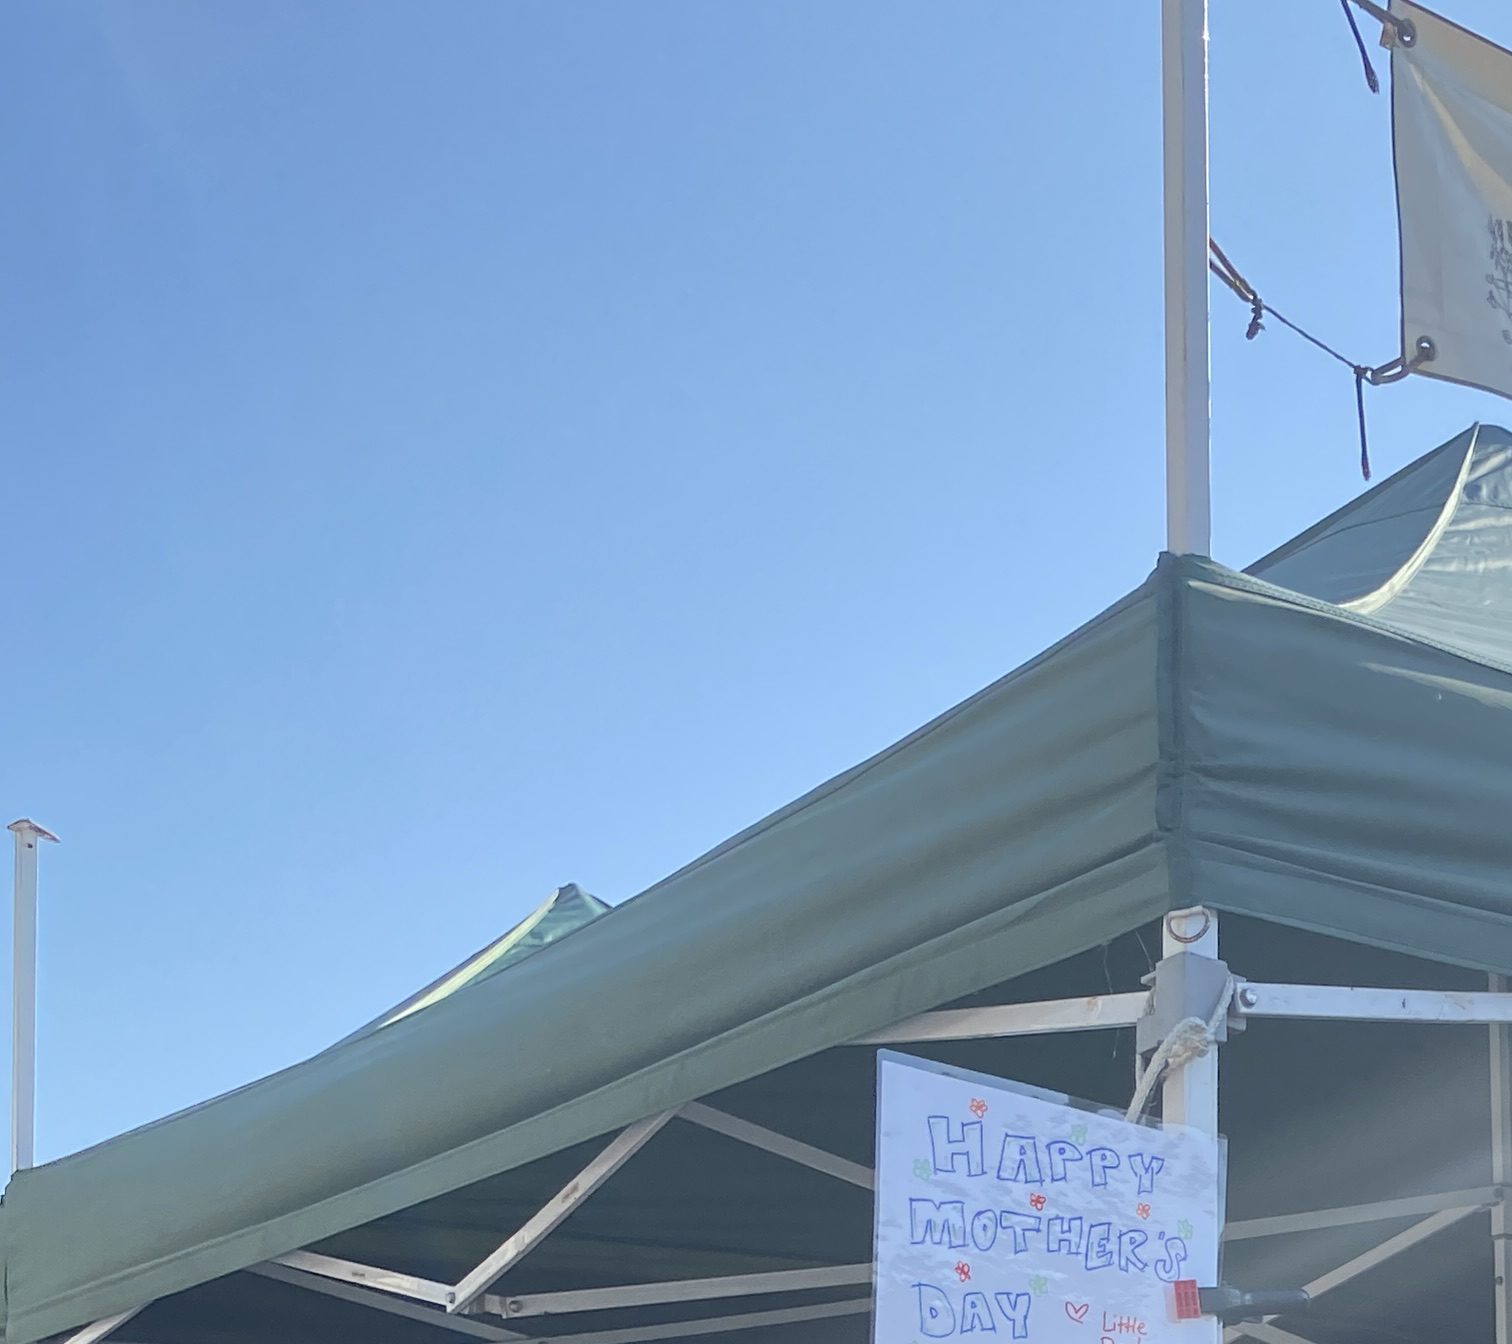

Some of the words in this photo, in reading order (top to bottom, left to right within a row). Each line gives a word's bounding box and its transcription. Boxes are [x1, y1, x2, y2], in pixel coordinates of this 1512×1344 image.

[926, 1114, 1165, 1195] HAPPY
[909, 1197, 1189, 1283] MOTHER'S
[911, 1281, 1032, 1340] DAY
[1102, 1310, 1148, 1336] Little
